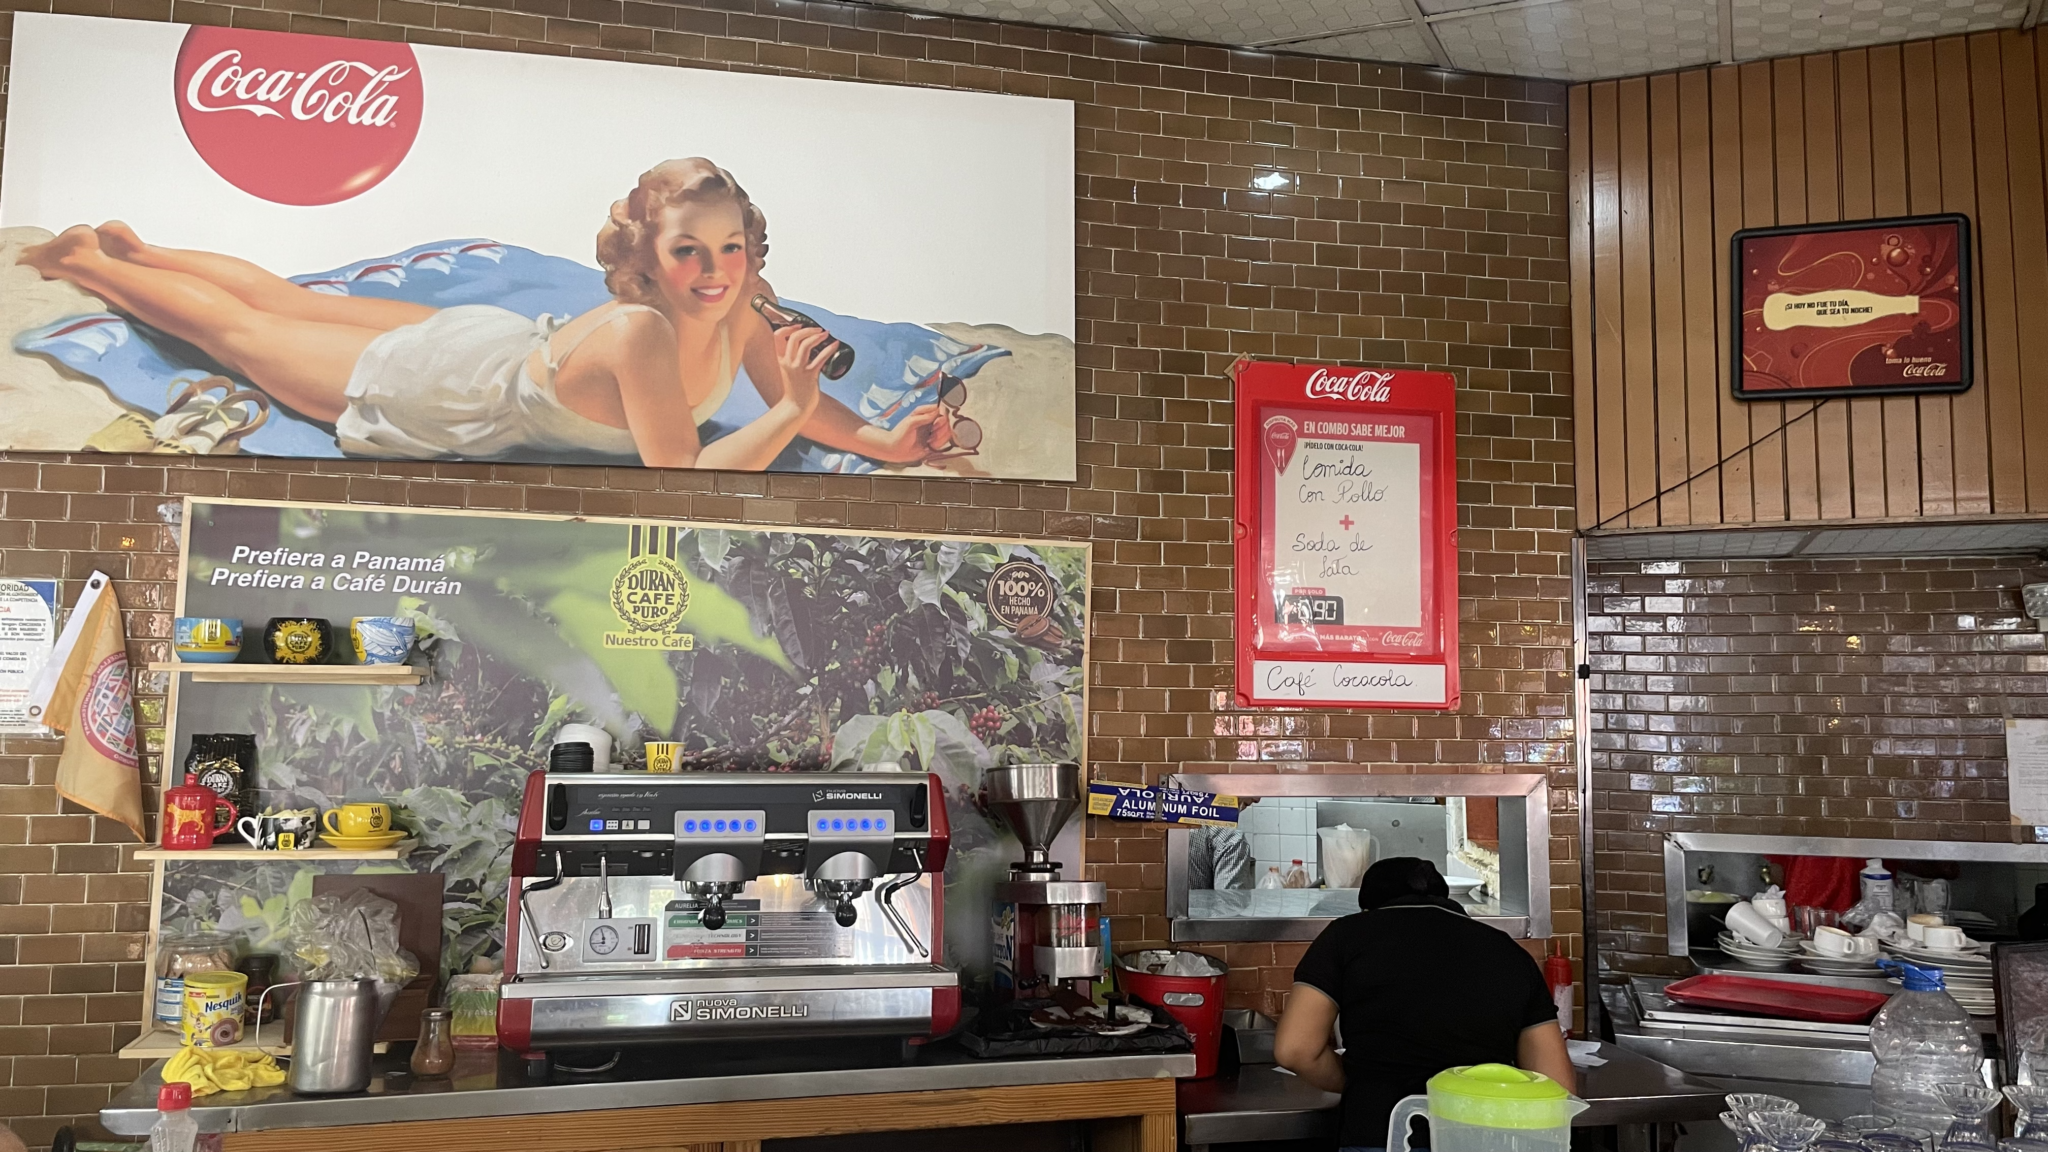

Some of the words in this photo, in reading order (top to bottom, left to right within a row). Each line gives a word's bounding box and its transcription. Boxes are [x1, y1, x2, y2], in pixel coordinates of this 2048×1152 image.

[187, 49, 413, 127] Coca-Cola
[1816, 308, 1828, 316] QUE
[1850, 306, 1873, 314] NOCHE!
[1305, 368, 1395, 403] Coca-Cola
[1304, 421, 1316, 434] EN
[1317, 422, 1349, 436] COMBO
[1351, 423, 1373, 437] SABE
[1374, 424, 1405, 438] MEJOR
[1304, 441, 1324, 450] ¡PÍDELO
[1335, 443, 1364, 452] COCA-COLA!
[1299, 484, 1325, 504] Con
[1292, 532, 1341, 552] Soda
[1349, 532, 1374, 552] de
[231, 545, 324, 568] Prefiera
[331, 554, 346, 569] a
[352, 551, 446, 573] Panamá
[210, 567, 304, 589] Prefiera
[310, 576, 325, 590] a
[332, 573, 386, 593] Café
[392, 575, 462, 596] Durán
[627, 569, 676, 593] DURAN
[997, 580, 1045, 597] 100%
[626, 592, 675, 606] CAFE
[1009, 597, 1031, 606] HECHO
[632, 605, 669, 619] PURO
[1001, 605, 1010, 615] EN
[605, 634, 658, 648] Nuestro
[662, 635, 692, 648] Café
[1382, 630, 1424, 647] Coca-Cola
[1267, 664, 1316, 696] Café
[826, 792, 882, 800] SIMONELLI
[1122, 799, 1187, 815] ALUMNUM
[1191, 805, 1220, 818] FOIL
[205, 991, 242, 1013] Nesquik
[697, 998, 737, 1007] nuova
[696, 1005, 808, 1020] SIMONELLI
